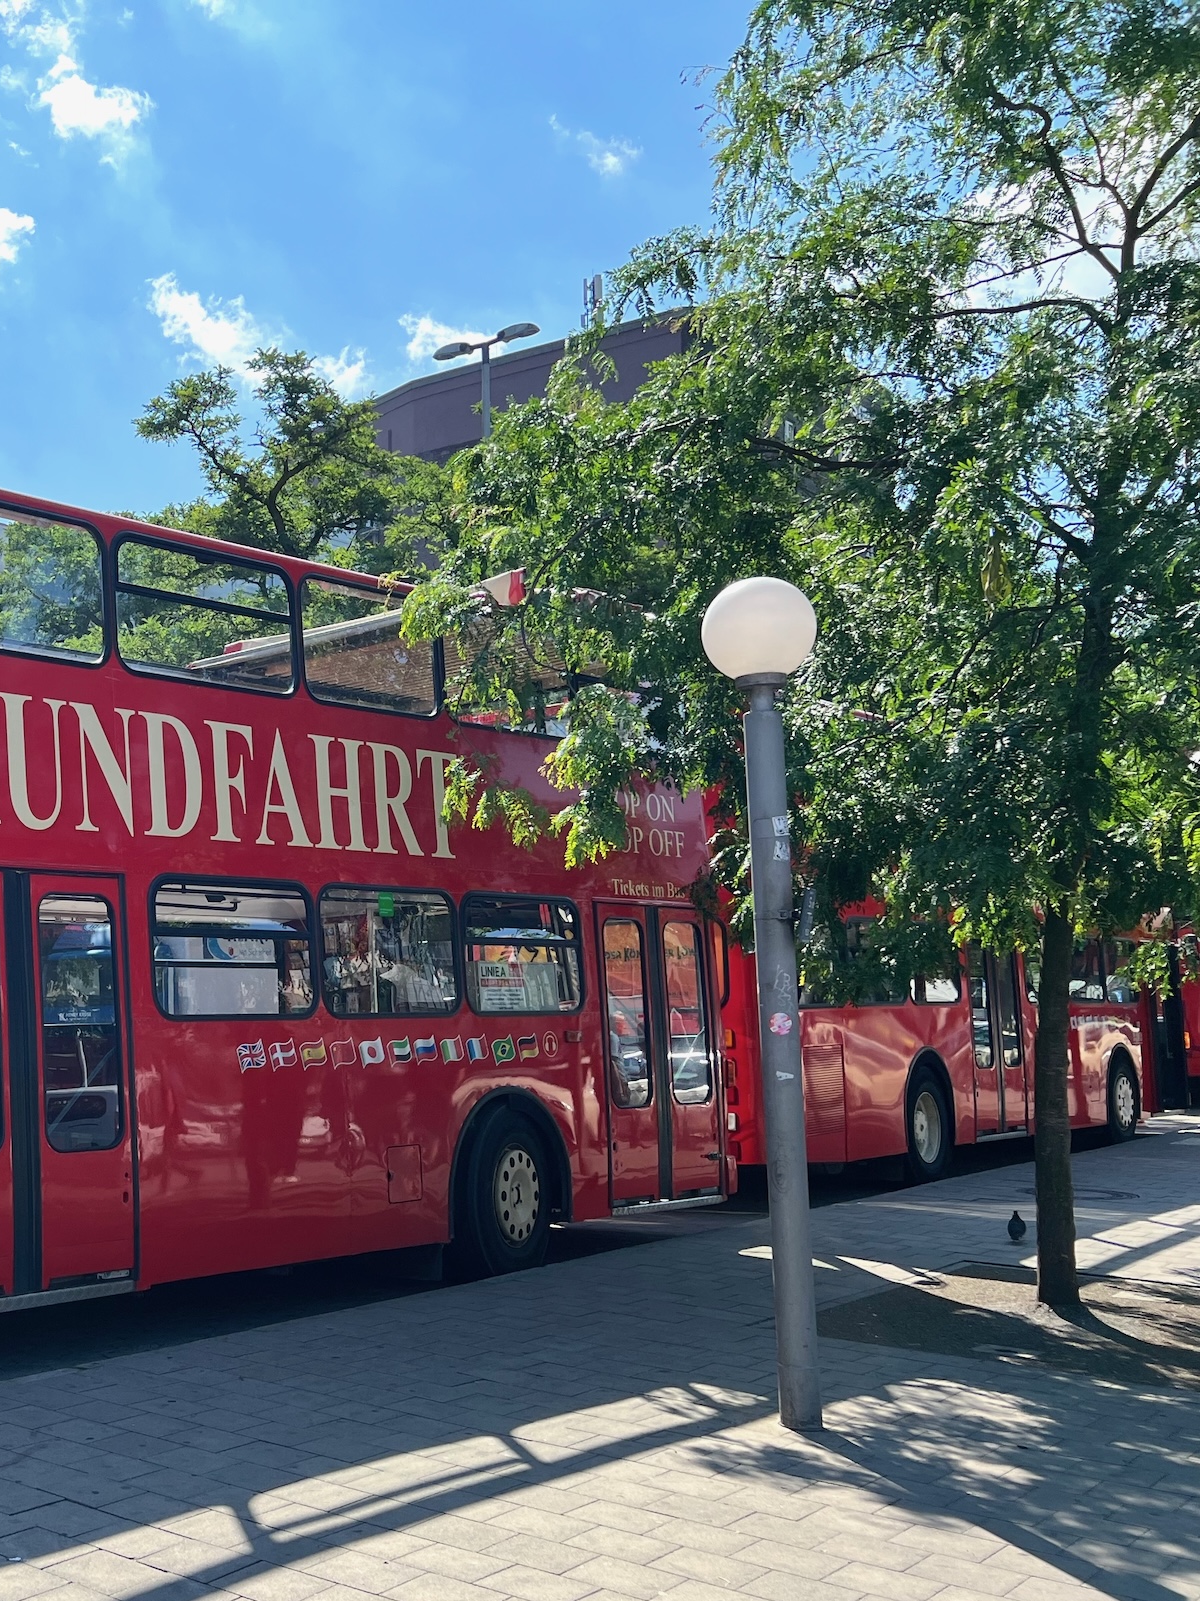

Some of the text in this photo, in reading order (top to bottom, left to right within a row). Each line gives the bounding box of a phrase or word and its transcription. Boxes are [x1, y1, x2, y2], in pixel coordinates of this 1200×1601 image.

[613, 790, 675, 823] OP ON
[648, 828, 685, 858] OFF
[611, 878, 650, 897] Tickets
[652, 881, 665, 897] im
